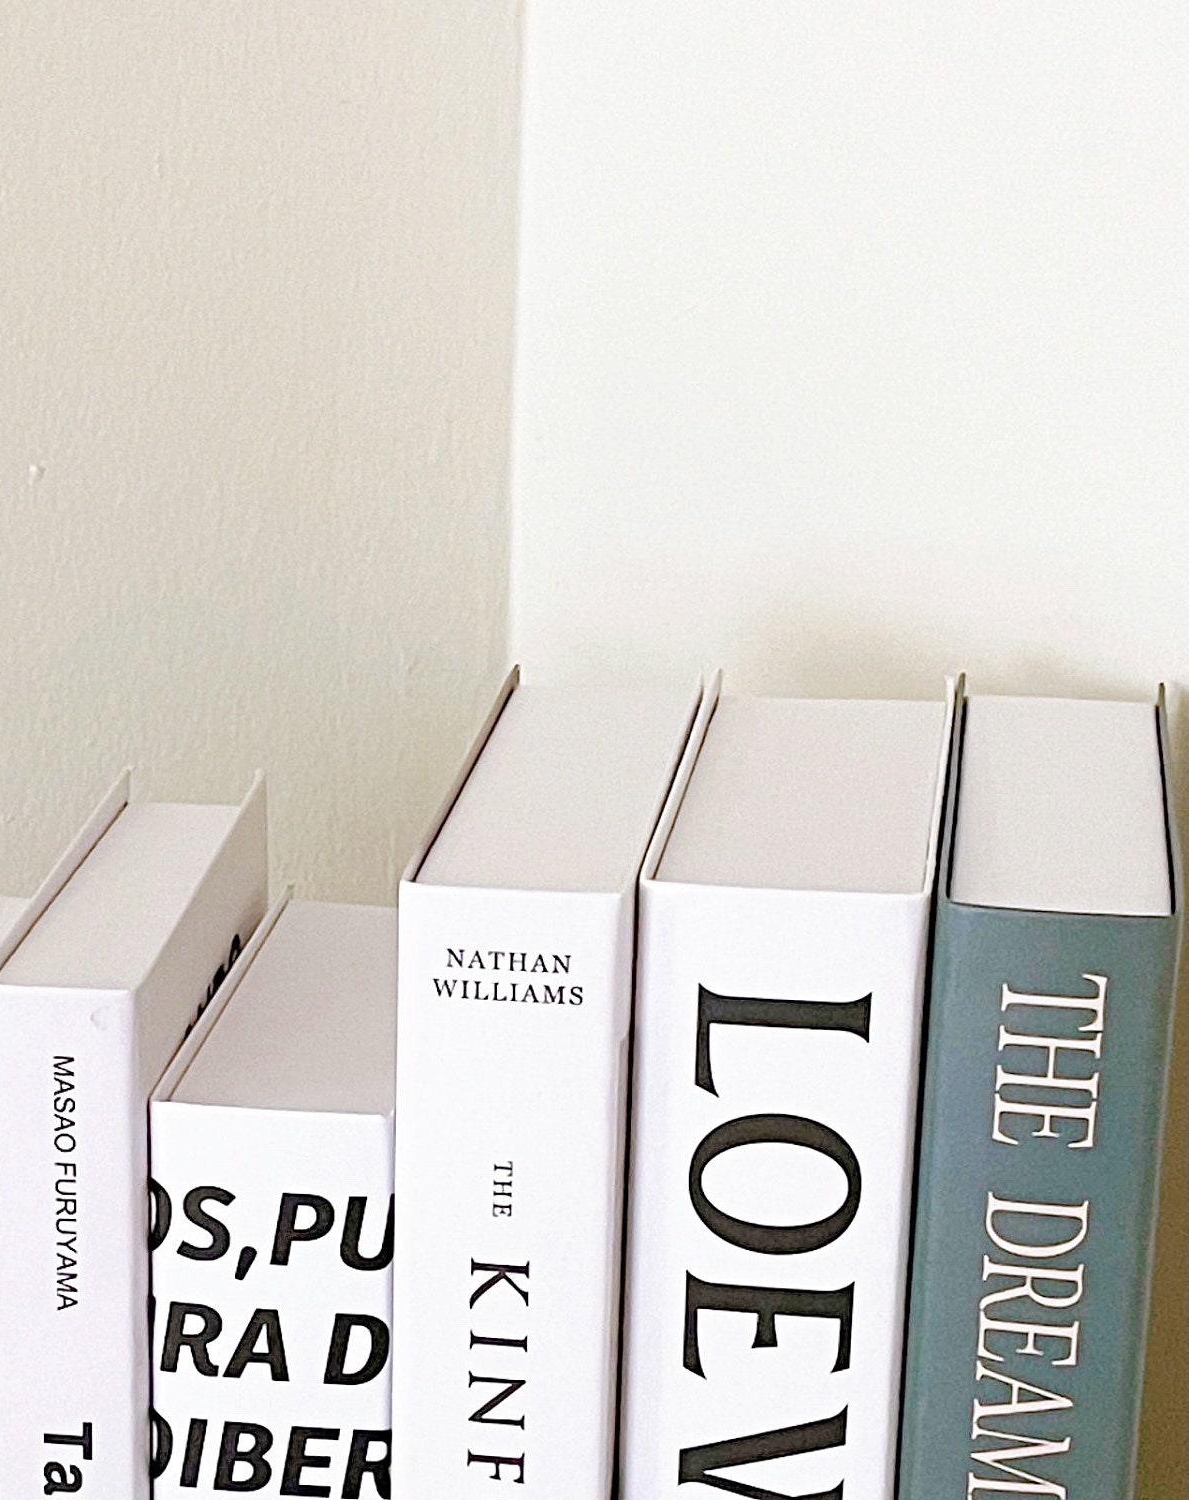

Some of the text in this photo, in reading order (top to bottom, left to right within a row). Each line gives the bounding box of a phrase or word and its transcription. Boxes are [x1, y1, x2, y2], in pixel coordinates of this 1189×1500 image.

[432, 978, 584, 1006] WILLIAMS
[446, 947, 572, 974] NATHAN
[992, 972, 1109, 1149] THE
[52, 1055, 79, 1311] MASAO FURUYAMA
[491, 1160, 514, 1218] THE
[150, 1300, 290, 1382] RA
